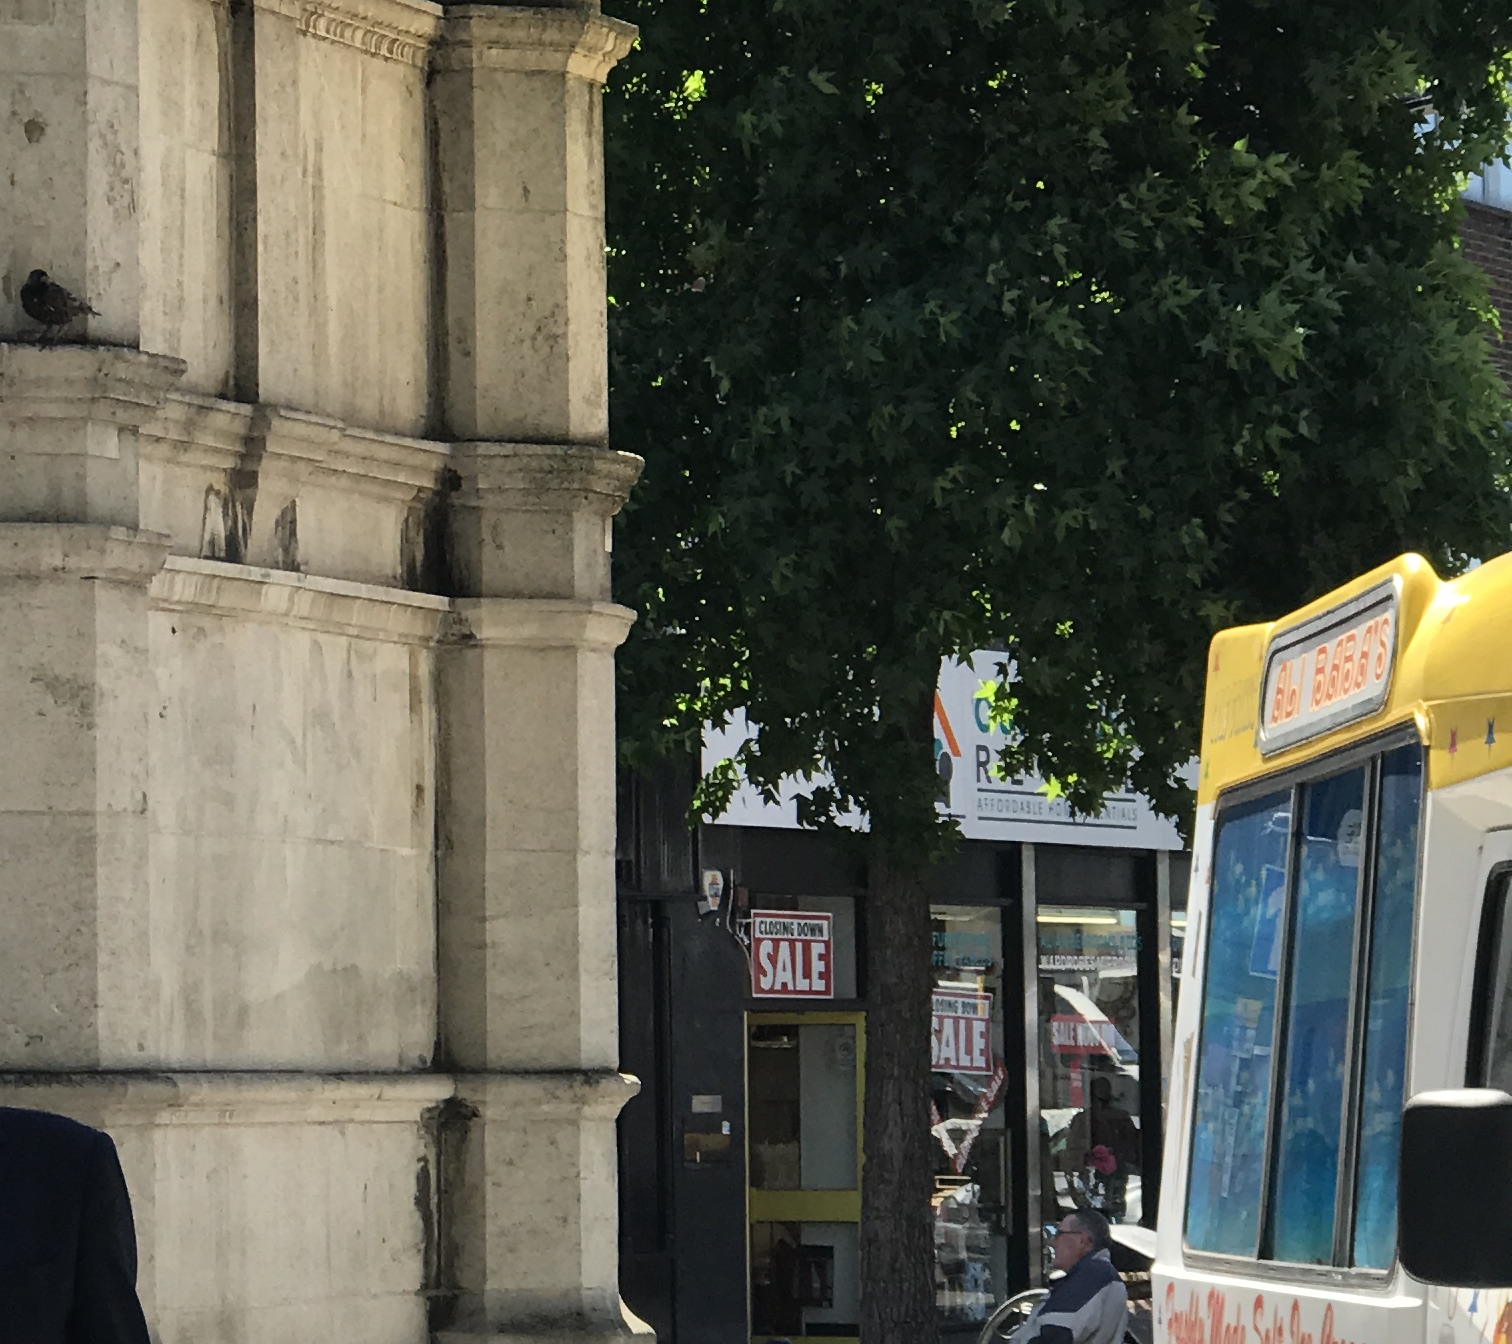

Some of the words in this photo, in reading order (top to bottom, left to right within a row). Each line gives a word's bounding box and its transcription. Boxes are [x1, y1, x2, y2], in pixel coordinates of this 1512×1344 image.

[977, 796, 1043, 817] AFFORDABLE
[758, 920, 794, 937] CLOSING
[797, 921, 824, 938] DOWN
[759, 939, 826, 991] SALE
[931, 1016, 986, 1068] SALE
